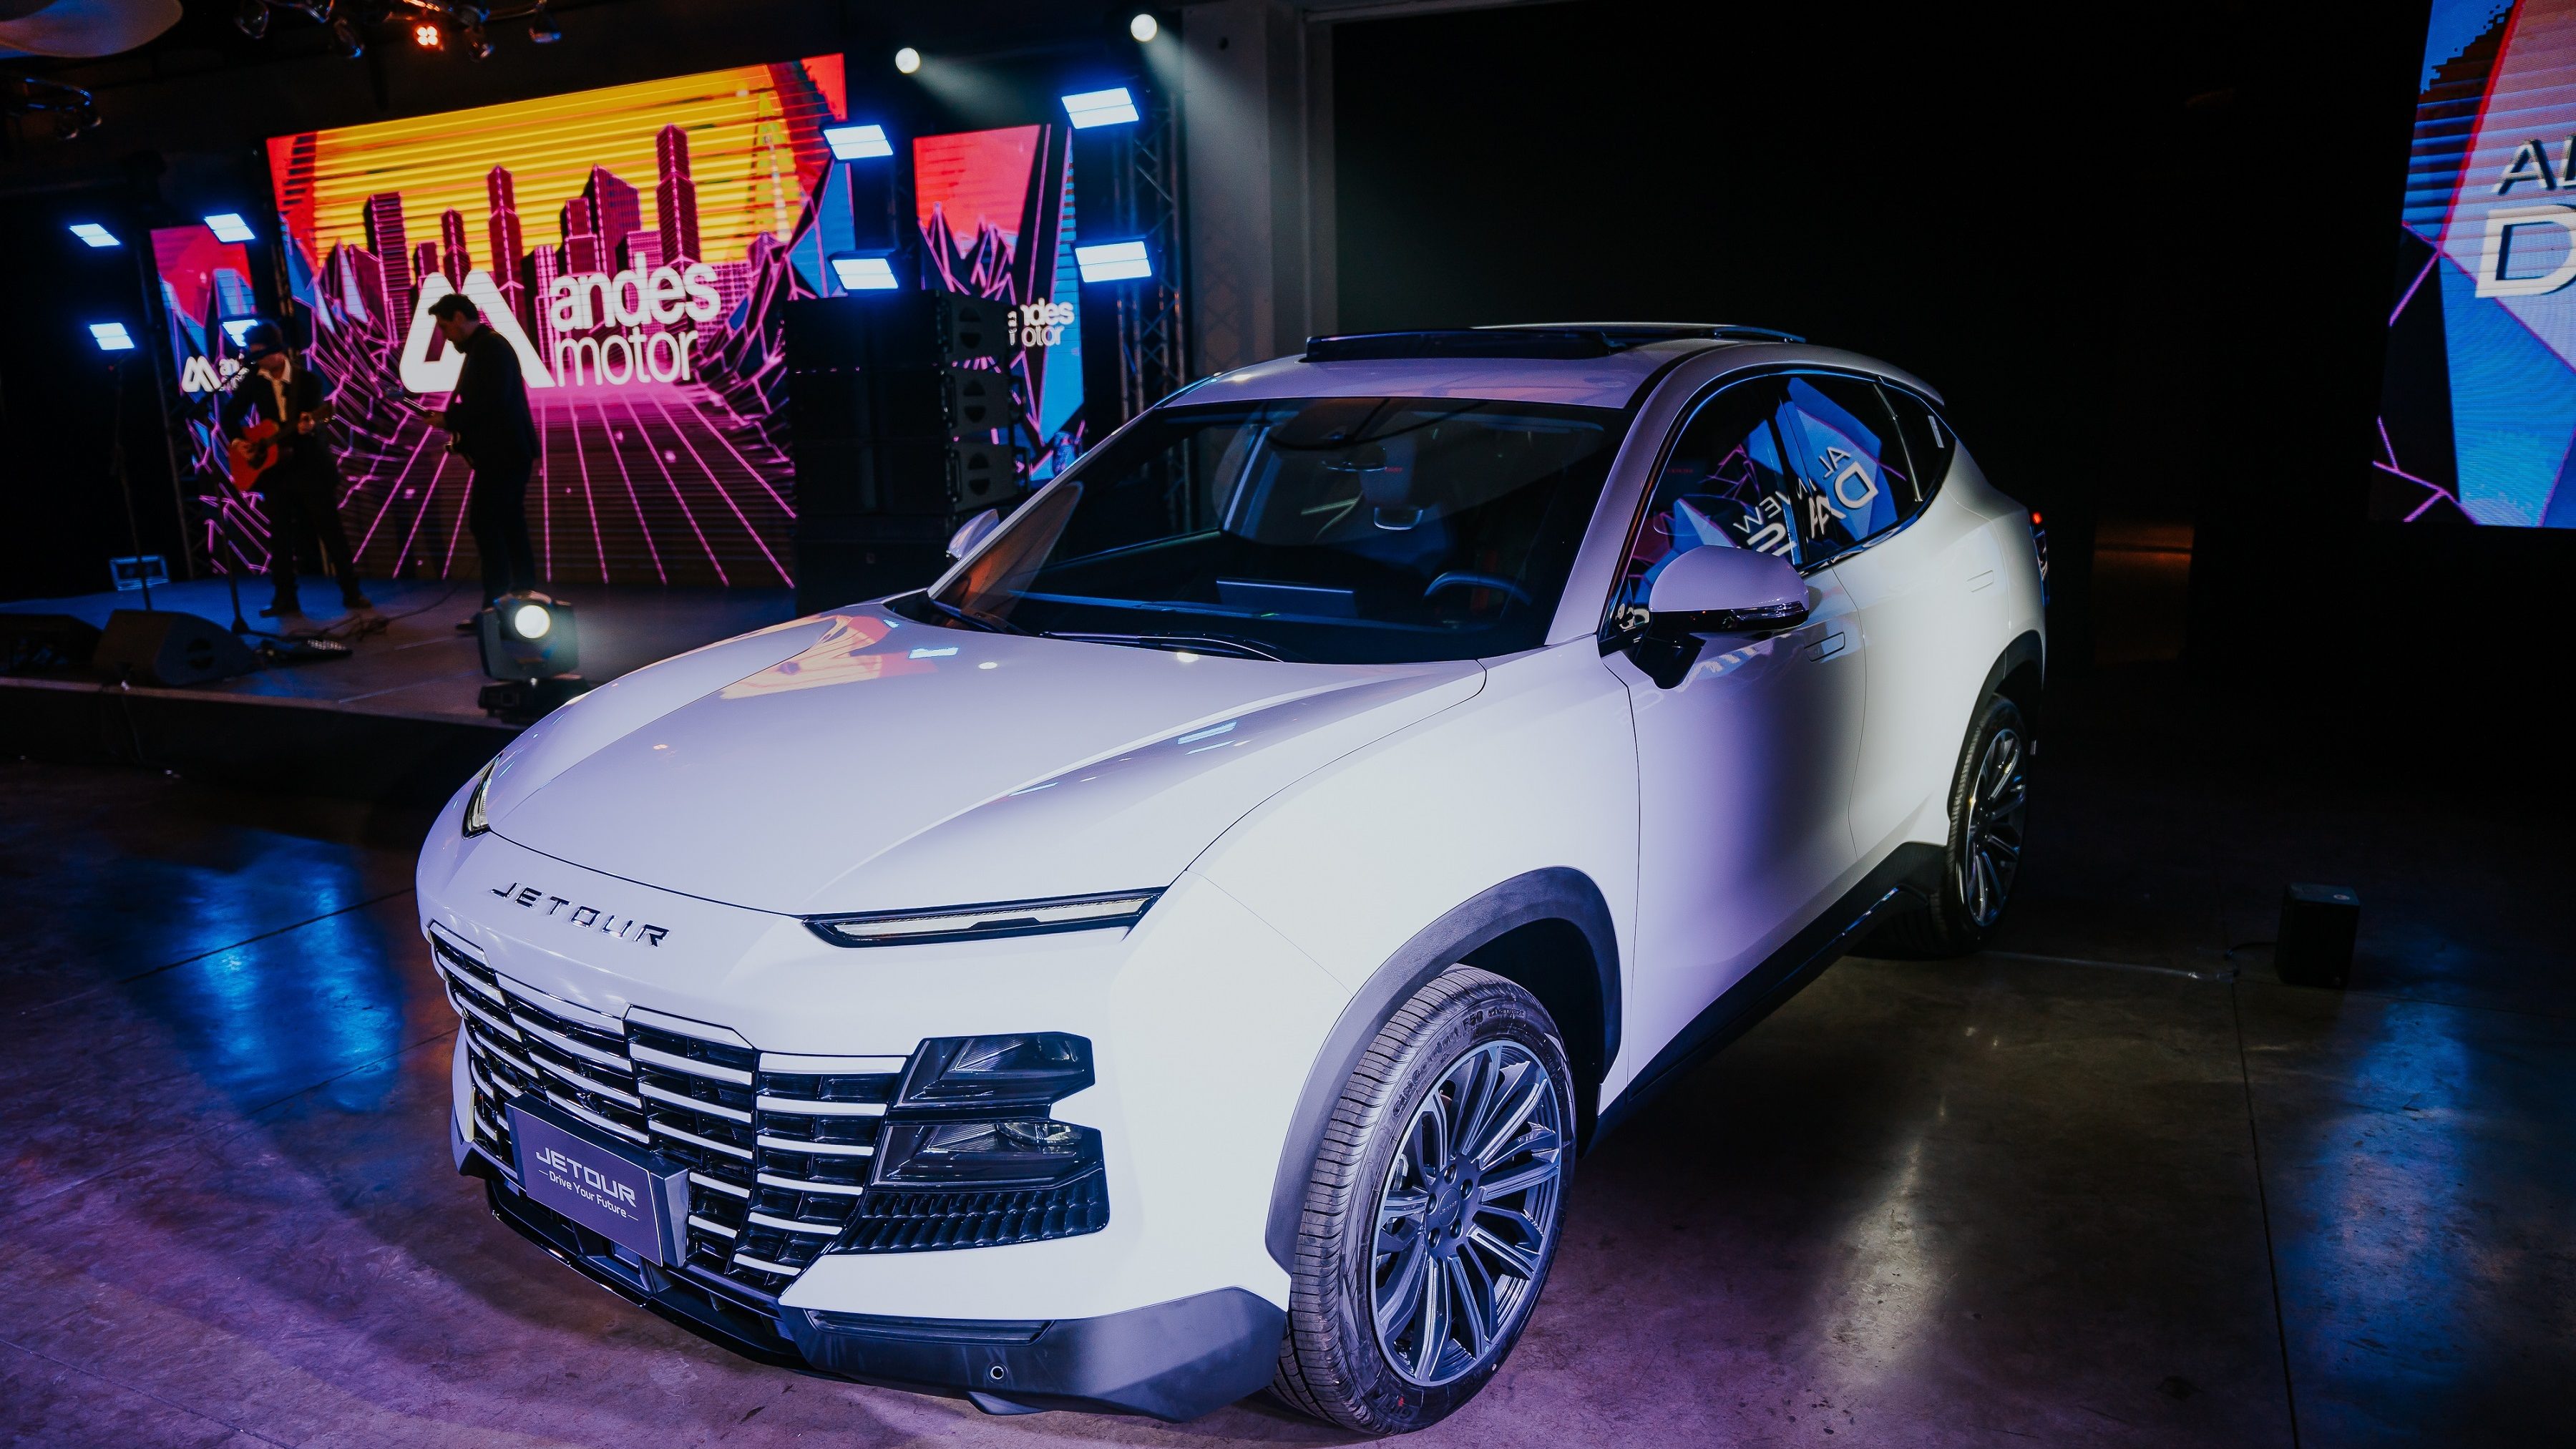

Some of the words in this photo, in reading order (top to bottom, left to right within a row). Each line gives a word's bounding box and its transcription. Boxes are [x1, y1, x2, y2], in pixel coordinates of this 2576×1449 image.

[550, 251, 721, 332] andes
[555, 326, 698, 388] motor
[490, 882, 670, 947] JETOUR
[536, 1147, 637, 1208] JETOUR
[549, 1170, 572, 1191] Drive
[572, 1182, 595, 1201] Your
[596, 1194, 627, 1218] Future
